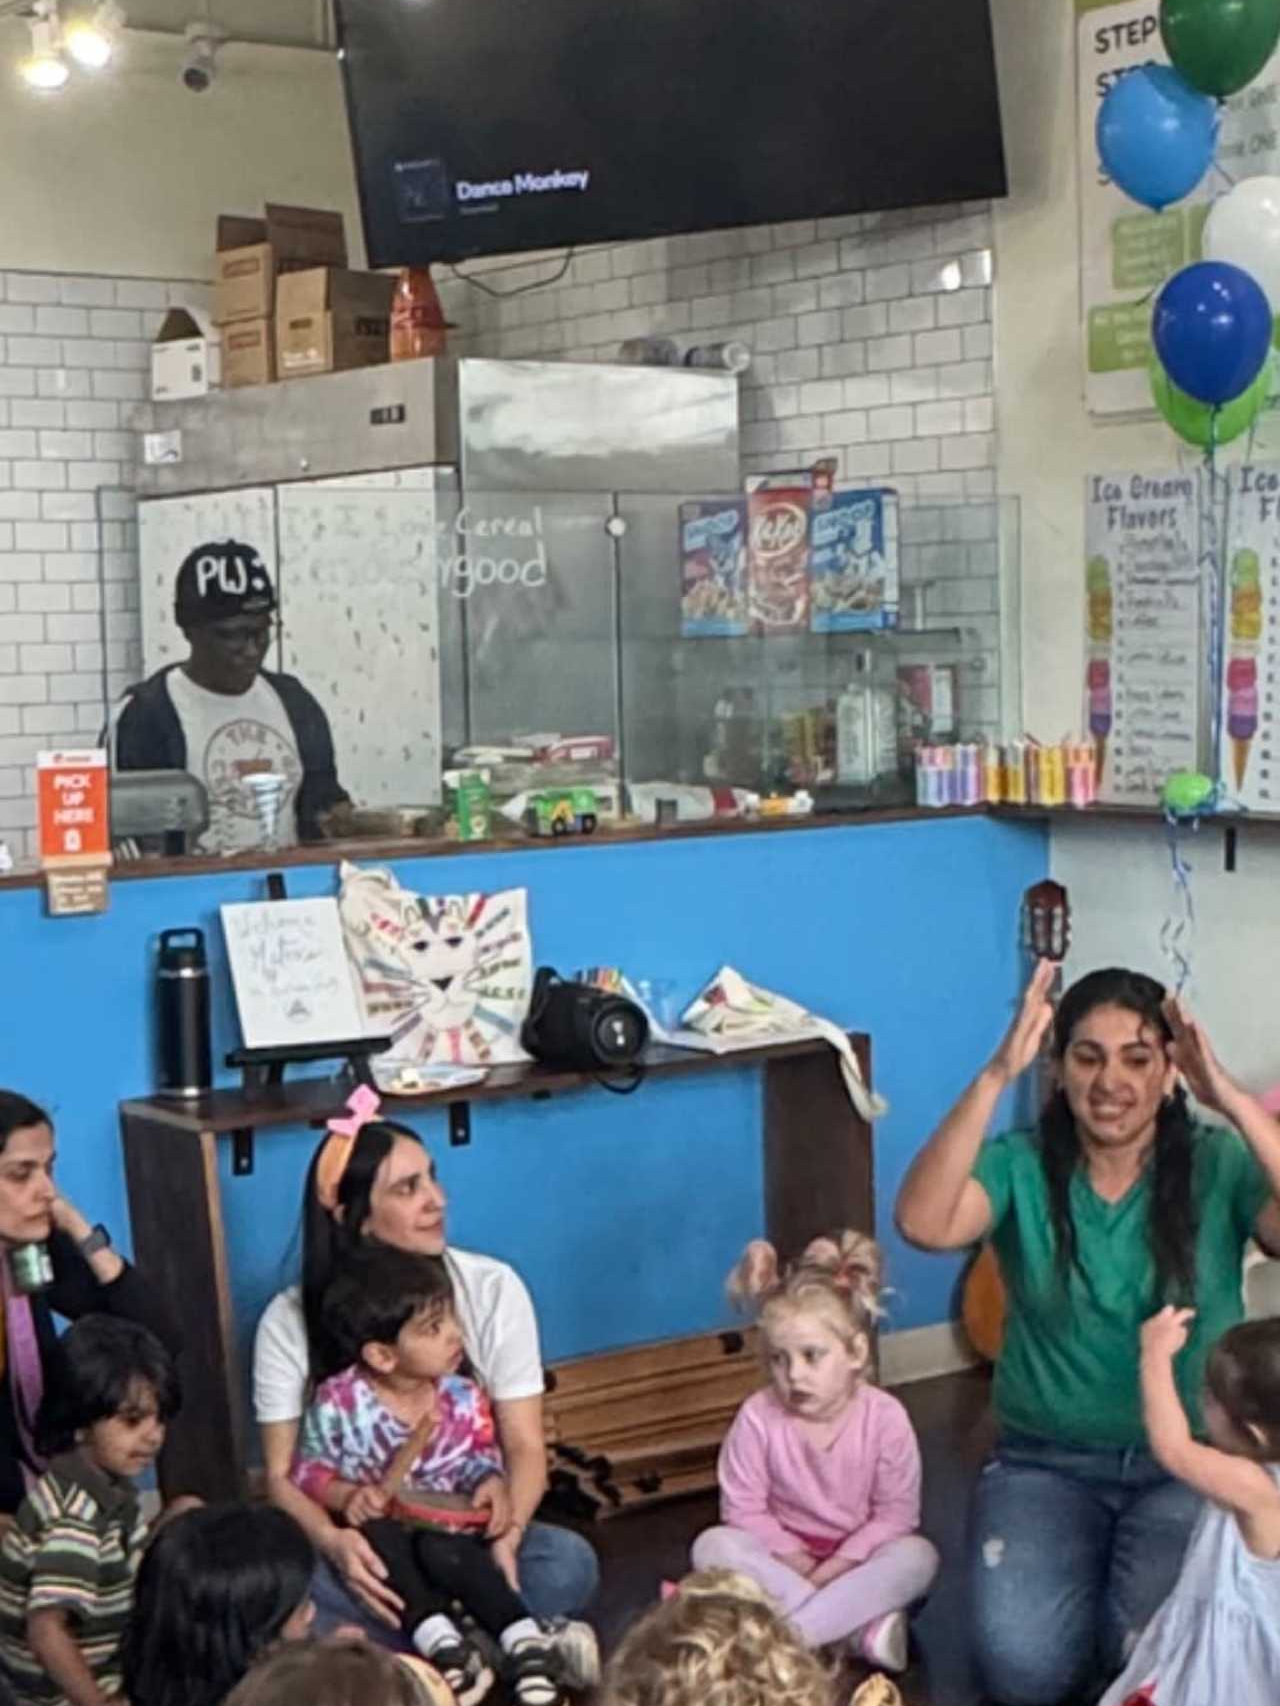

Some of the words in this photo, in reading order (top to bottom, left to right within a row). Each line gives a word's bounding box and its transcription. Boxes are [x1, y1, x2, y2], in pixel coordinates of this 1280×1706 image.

[1094, 15, 1158, 54] STEP
[456, 181, 513, 200] Dance
[515, 169, 588, 194] Monkey
[1092, 476, 1121, 503] Ice
[1129, 473, 1193, 501] Cream
[1238, 465, 1279, 493] Ice
[455, 506, 543, 537] Cereal
[1106, 506, 1177, 530] Flavors
[53, 773, 93, 790] PICK
[61, 791, 85, 806] UP
